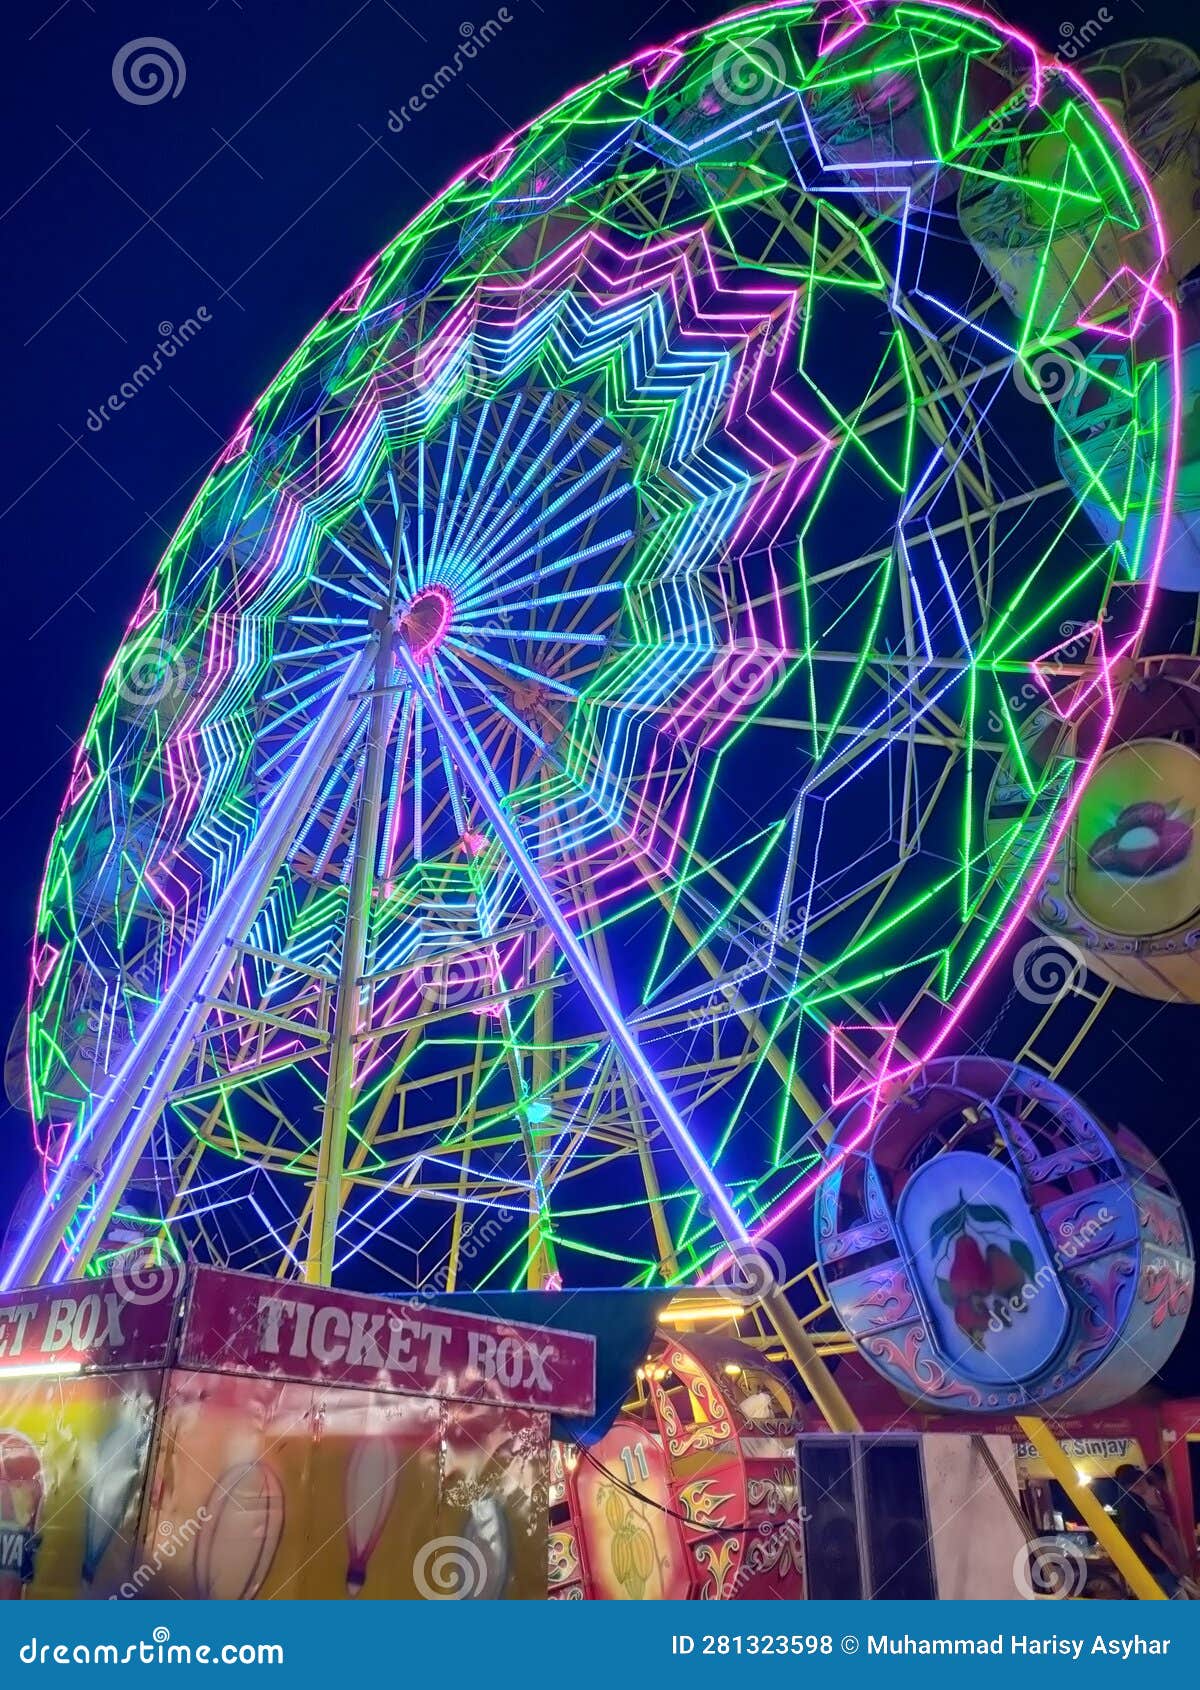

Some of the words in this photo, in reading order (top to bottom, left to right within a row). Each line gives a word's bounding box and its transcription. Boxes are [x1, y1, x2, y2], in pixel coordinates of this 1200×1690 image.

[40, 1292, 135, 1352] BOX
[257, 1297, 451, 1376] TICKET
[467, 1332, 554, 1391] BOX
[620, 1442, 649, 1485] 11
[1073, 1438, 1128, 1459] Sinjay
